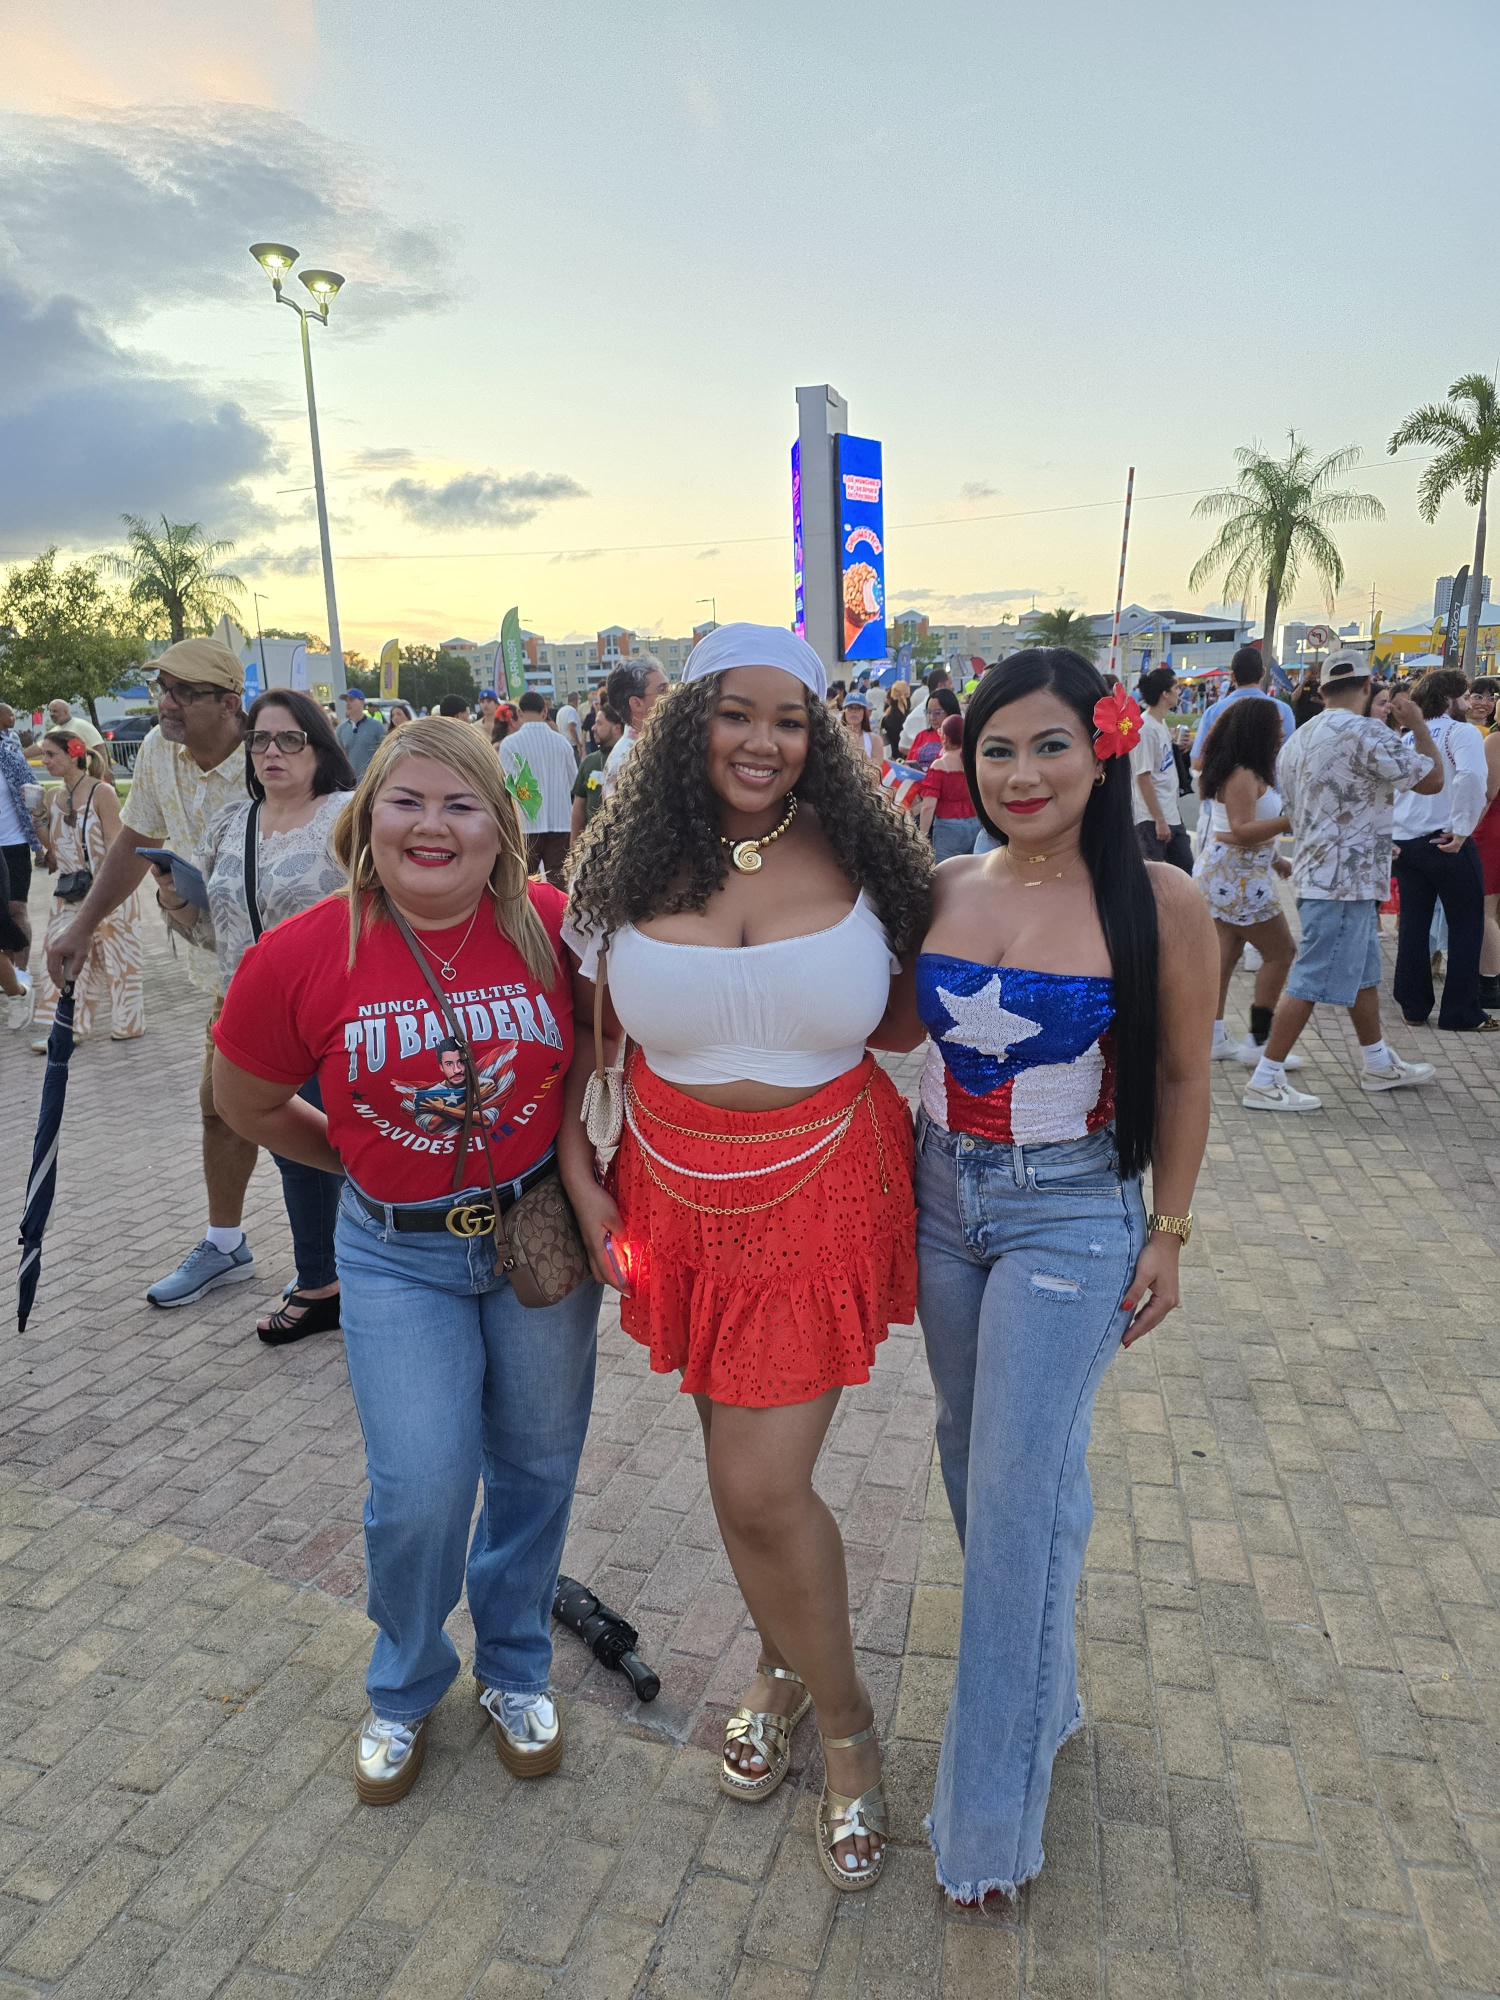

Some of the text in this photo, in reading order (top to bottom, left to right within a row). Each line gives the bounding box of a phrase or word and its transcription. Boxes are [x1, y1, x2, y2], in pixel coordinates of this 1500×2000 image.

[506, 638, 522, 688] GARNIER
[358, 983, 527, 1017] NUNCA SUELTES
[344, 993, 563, 1082] TU BANDERA
[352, 1103, 378, 1118] NI
[372, 1119, 456, 1154] OLVIDES
[490, 1121, 516, 1143] LE
[513, 1103, 538, 1125] LO
